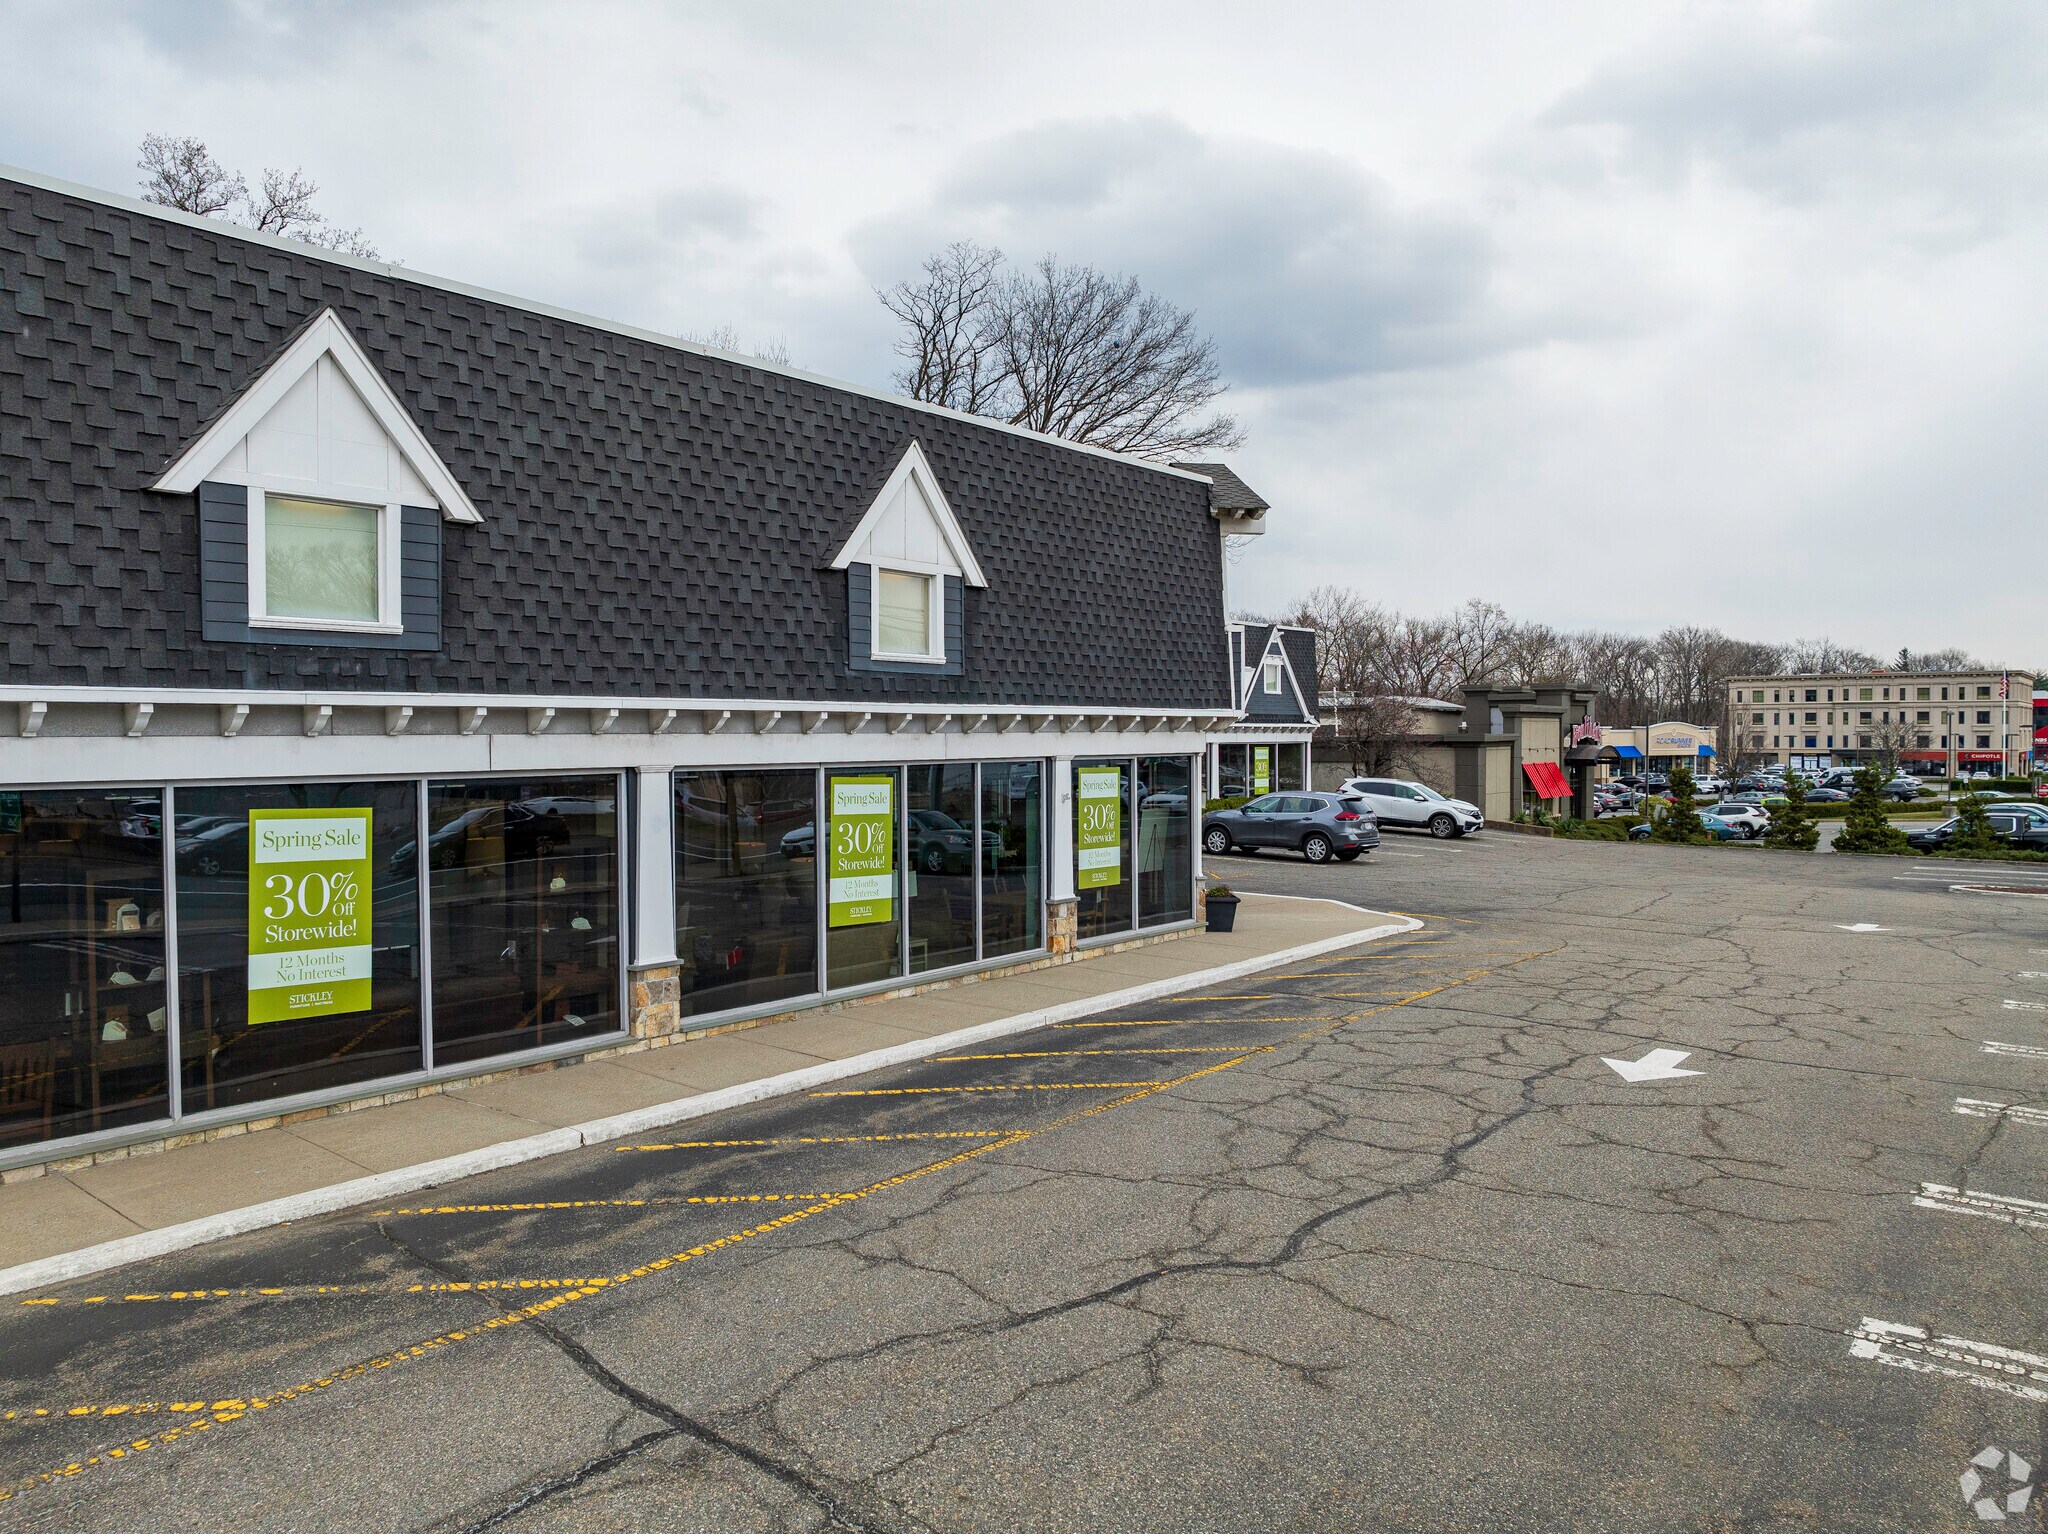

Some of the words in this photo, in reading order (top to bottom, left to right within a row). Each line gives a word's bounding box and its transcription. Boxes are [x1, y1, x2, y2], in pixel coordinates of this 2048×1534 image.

[1083, 780, 1103, 792] Spring
[1104, 779, 1116, 789] Sale
[838, 792, 867, 807] Spring
[869, 791, 887, 804] Sale
[1084, 804, 1116, 830] 30%
[263, 830, 322, 852] Spring
[325, 829, 361, 846] Sale
[838, 822, 886, 854] 30%
[872, 844, 885, 854] Off
[1084, 831, 1116, 844] Storewide!
[839, 856, 885, 871] Storewide!
[845, 880, 853, 889] 12
[854, 879, 879, 888] Months
[264, 871, 359, 919] 30%
[333, 902, 356, 916] Off
[844, 890, 854, 899] No
[855, 889, 879, 898] Interest
[265, 919, 357, 943] Storewide!
[280, 957, 293, 969] 12
[297, 952, 345, 967] Months
[276, 970, 296, 983] No
[299, 966, 346, 981] Interest
[289, 991, 333, 1004] STICKLEY
